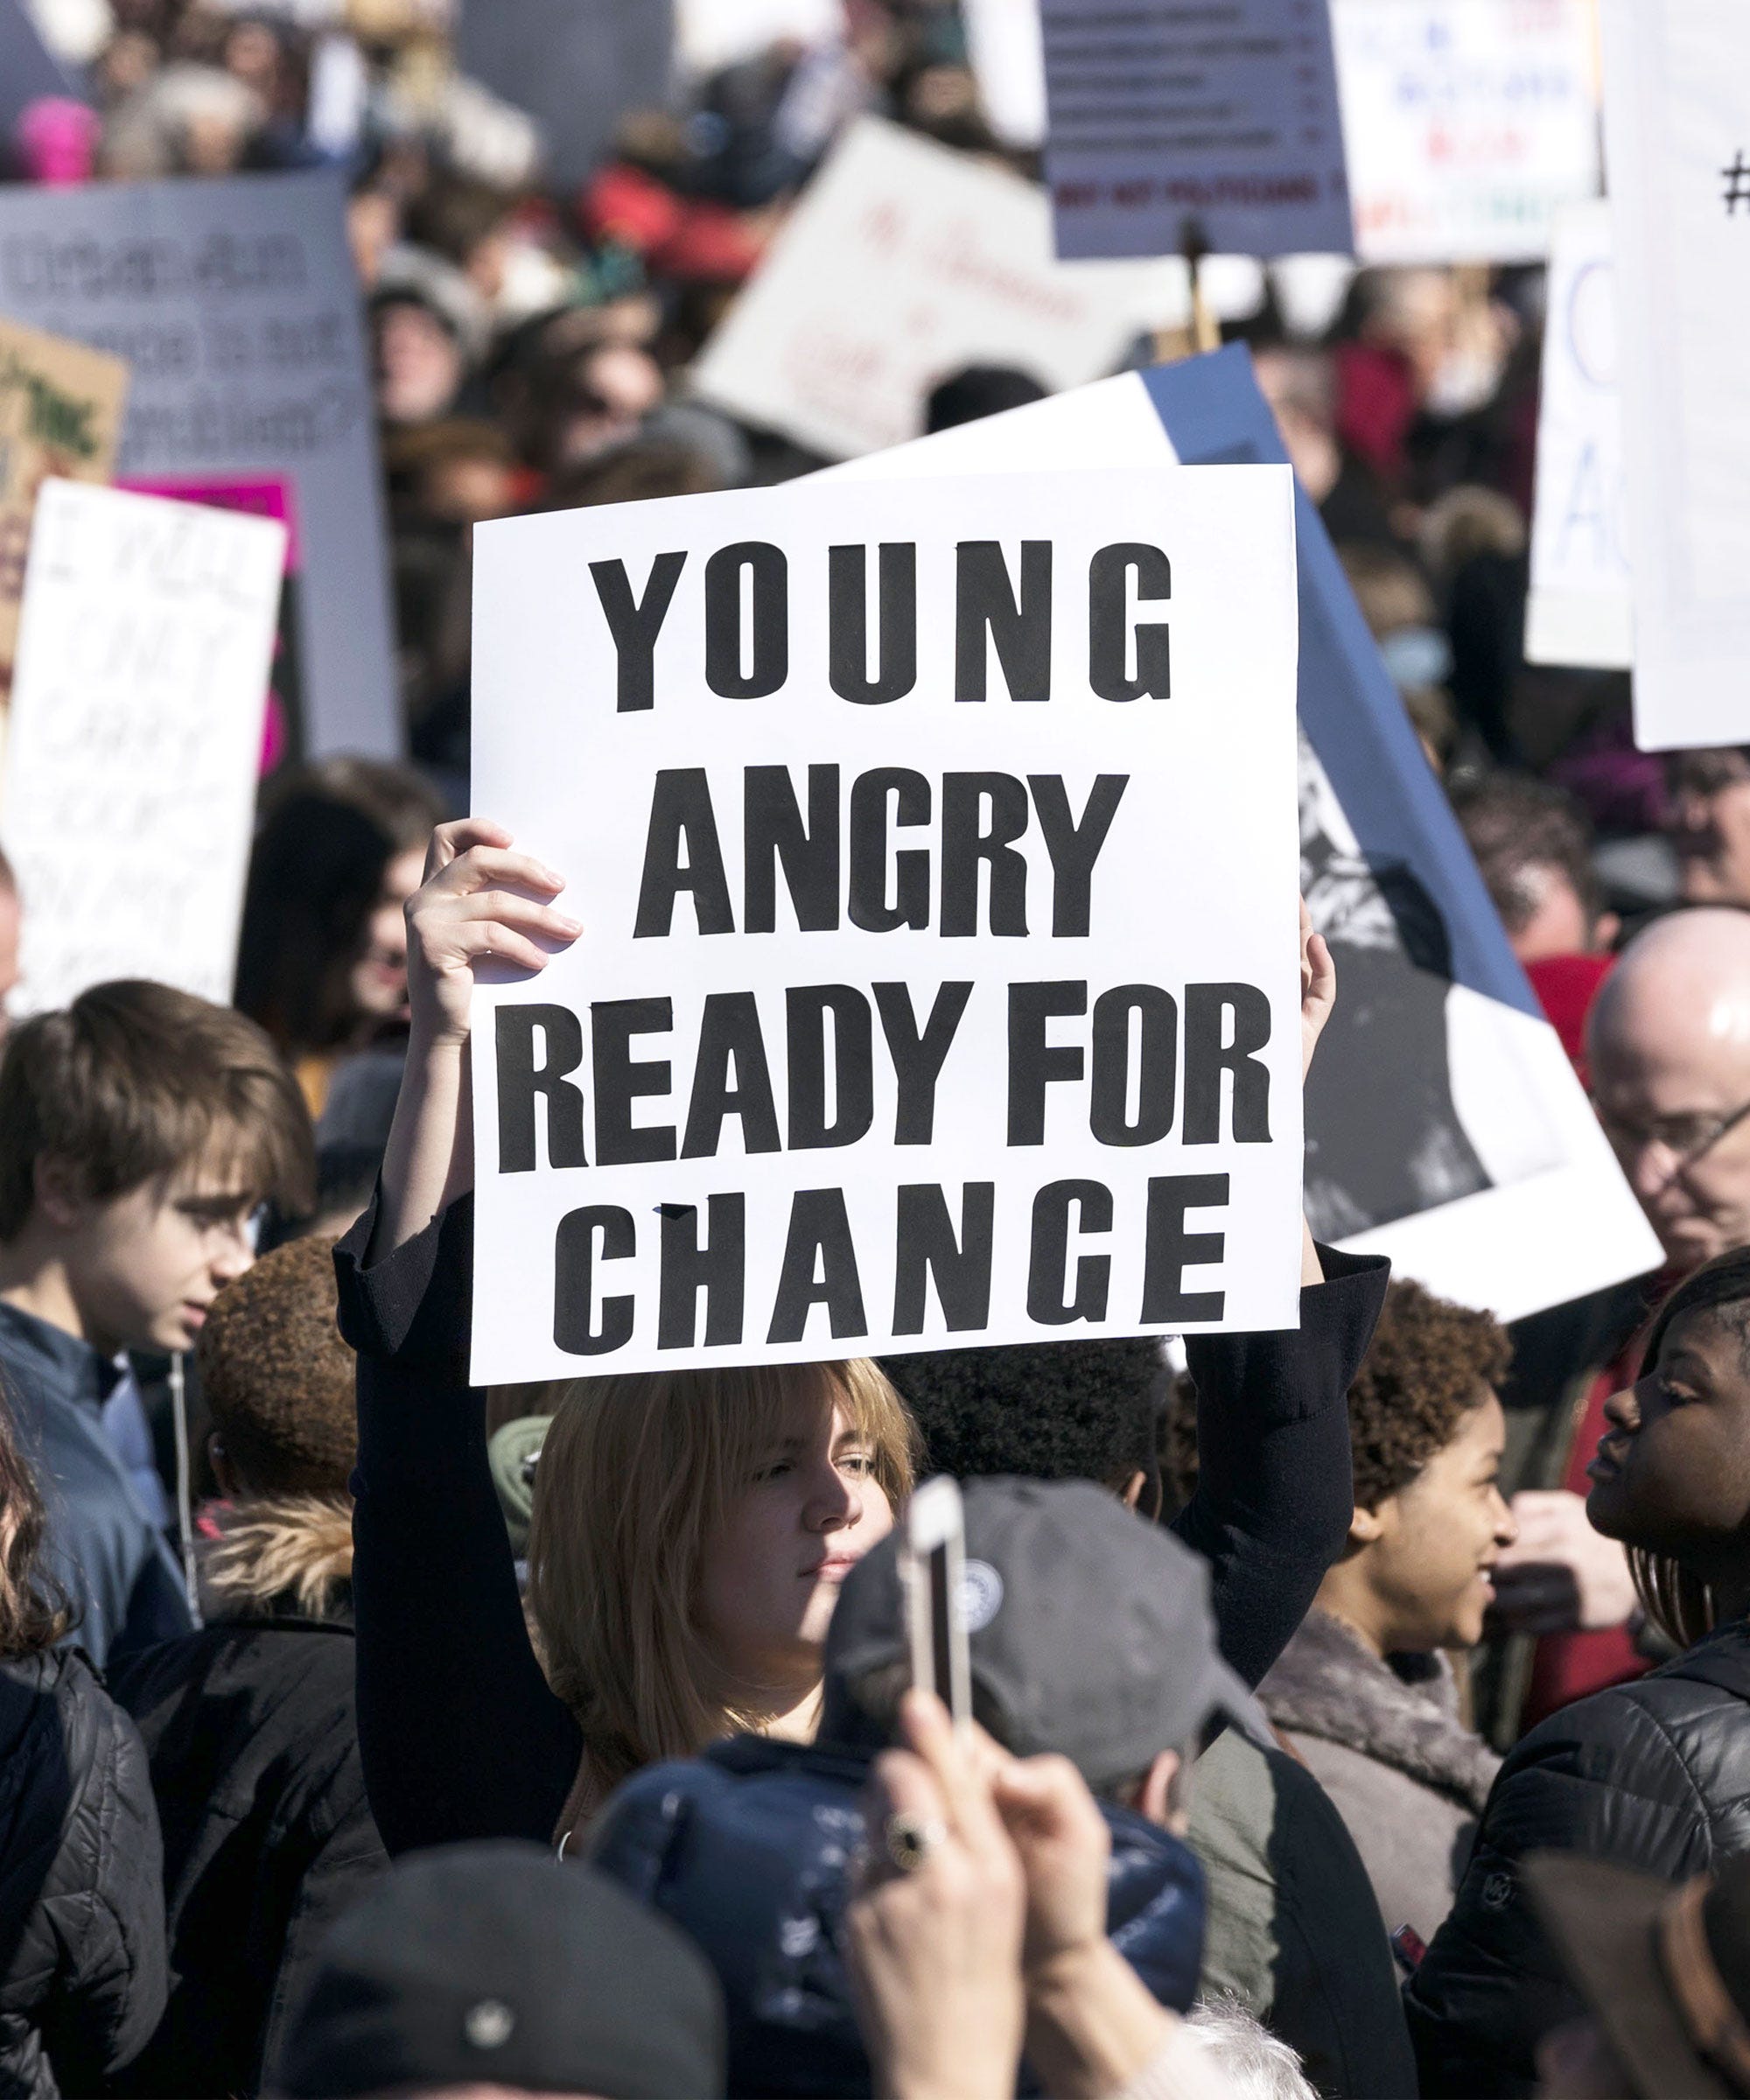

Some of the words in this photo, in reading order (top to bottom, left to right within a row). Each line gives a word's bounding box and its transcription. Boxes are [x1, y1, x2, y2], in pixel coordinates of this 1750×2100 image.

[588, 541, 1171, 712] YOUNG
[634, 764, 1130, 939] ANGRY
[495, 980, 974, 1174] READY
[1007, 980, 1272, 1146] FOR
[554, 1173, 1229, 1356] CHANGE
